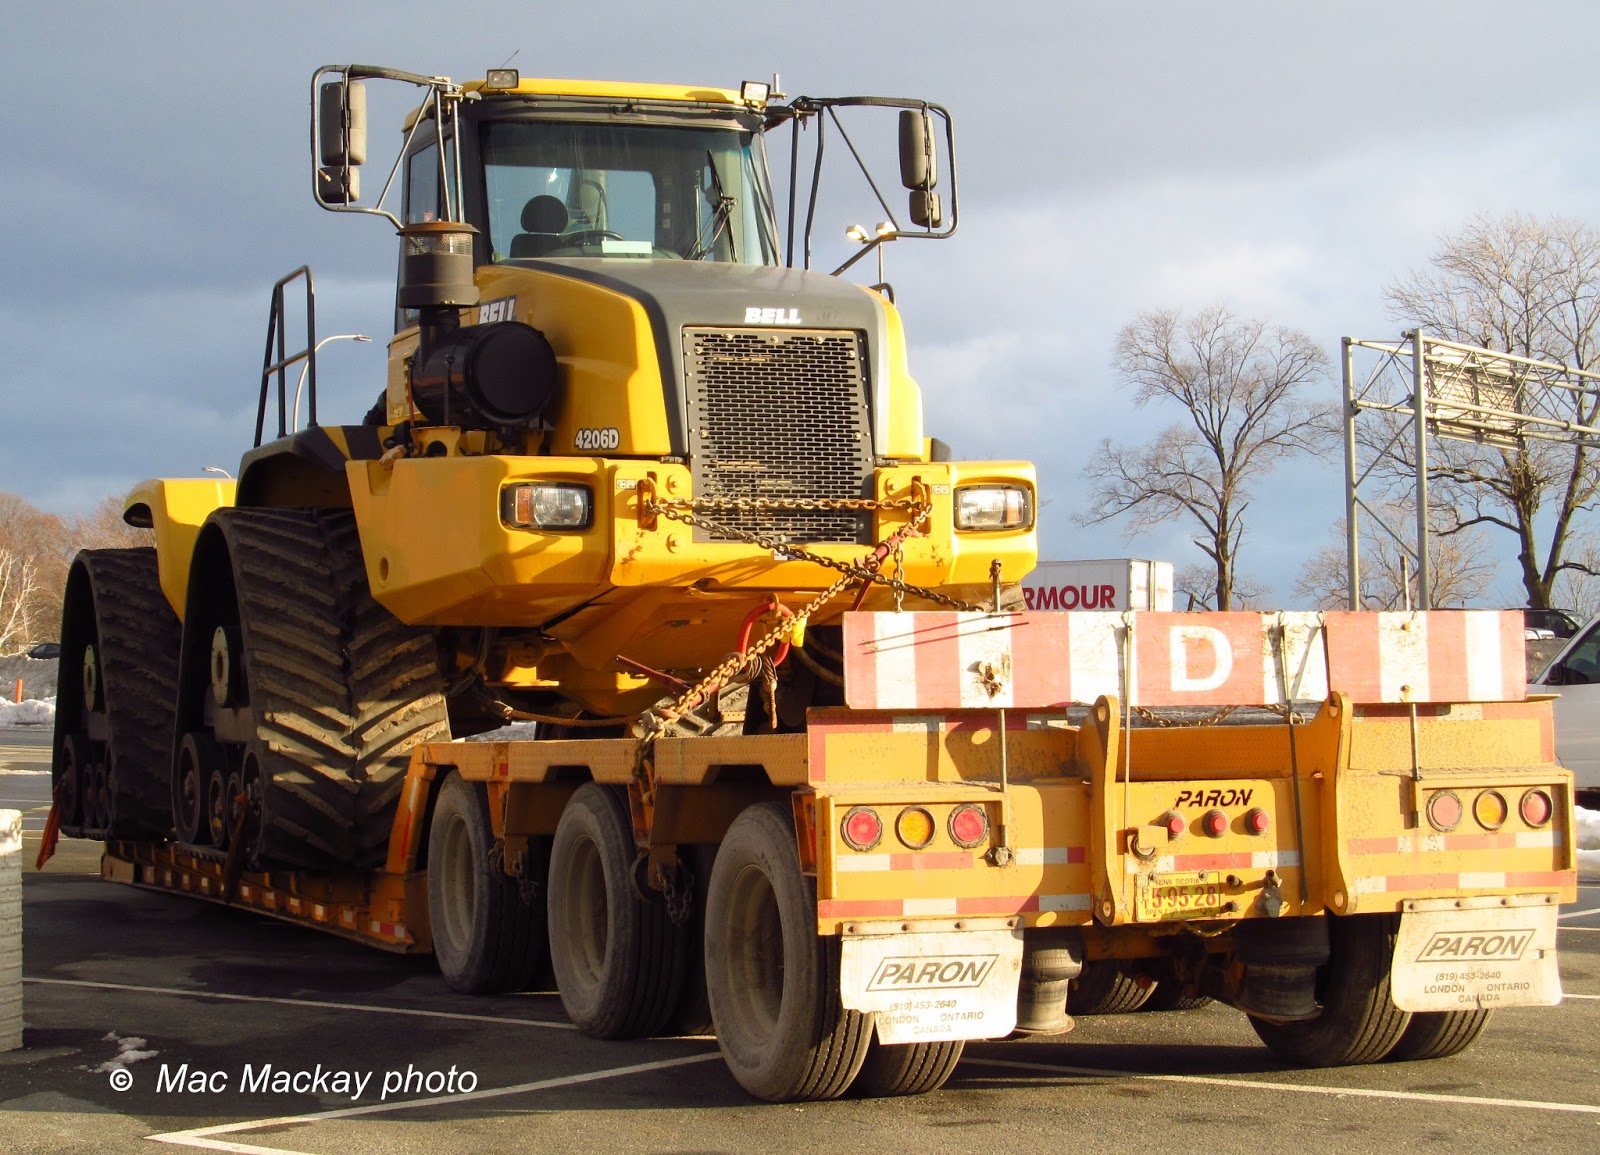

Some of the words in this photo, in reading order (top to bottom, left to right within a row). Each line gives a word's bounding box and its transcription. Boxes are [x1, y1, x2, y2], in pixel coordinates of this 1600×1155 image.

[744, 307, 802, 324] BELL
[574, 428, 620, 450] 4206D
[1169, 625, 1233, 692] D
[1175, 788, 1254, 808] PARON
[1155, 878, 1173, 886] NOVA
[1175, 877, 1200, 885] SCOTIA
[1145, 908, 1163, 916] OPEN
[1425, 935, 1526, 957] PARON
[876, 961, 988, 985] PARON
[1435, 972, 1458, 982] (519)
[1459, 971, 1501, 980] 453-2640
[1424, 984, 1465, 994] LONDON
[1487, 982, 1530, 992] ONTARIO
[914, 999, 957, 1010] 453-2640
[1458, 993, 1500, 1003] CANADA
[878, 1014, 920, 1026] LONDON
[940, 1011, 984, 1022] ONTARIO
[912, 1025, 952, 1035] CANADA
